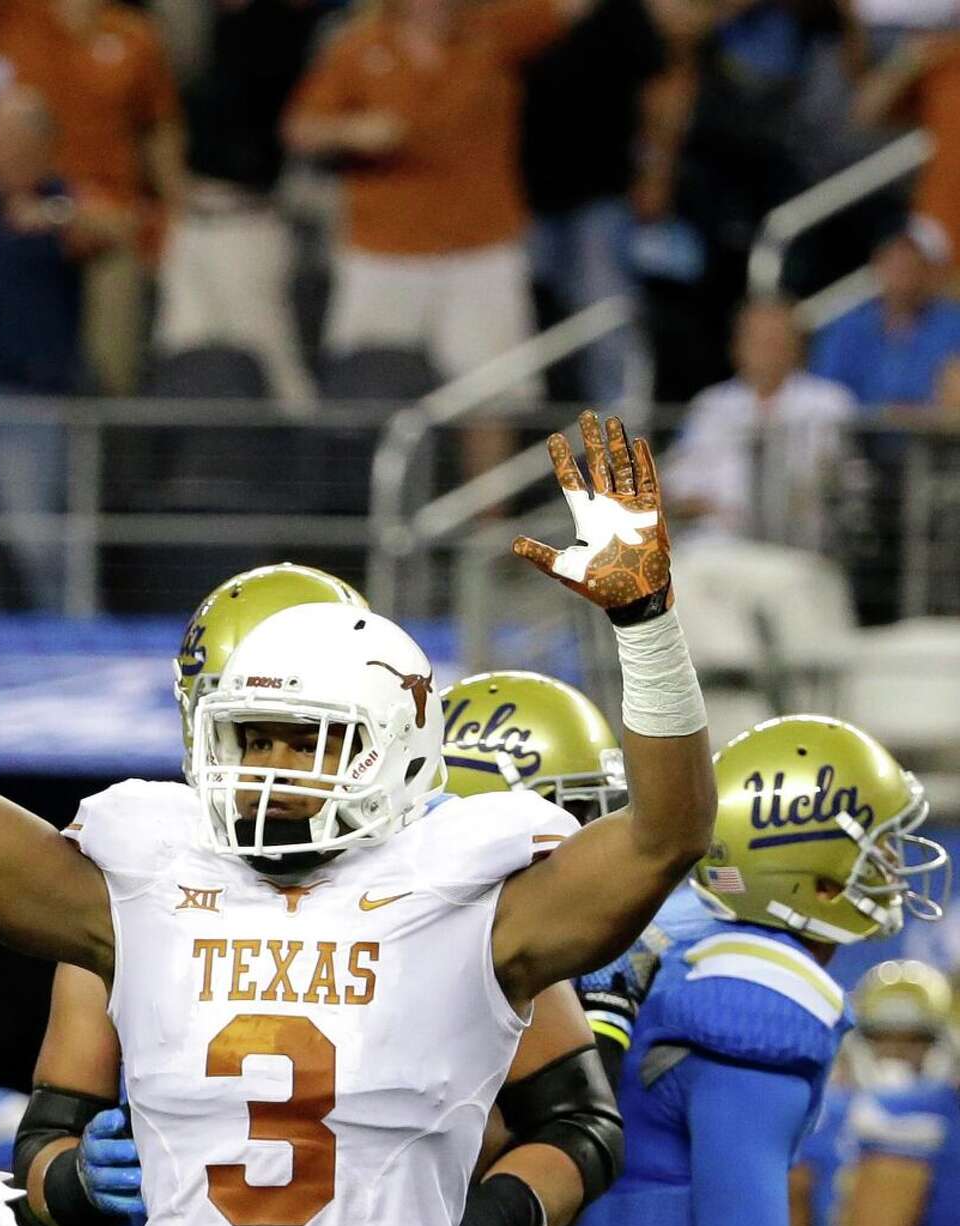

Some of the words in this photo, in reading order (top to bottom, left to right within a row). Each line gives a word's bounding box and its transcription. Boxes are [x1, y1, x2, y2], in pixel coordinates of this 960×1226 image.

[744, 765, 874, 832] Ucla
[192, 938, 380, 1005] TEXAS
[206, 1014, 336, 1226] 3
